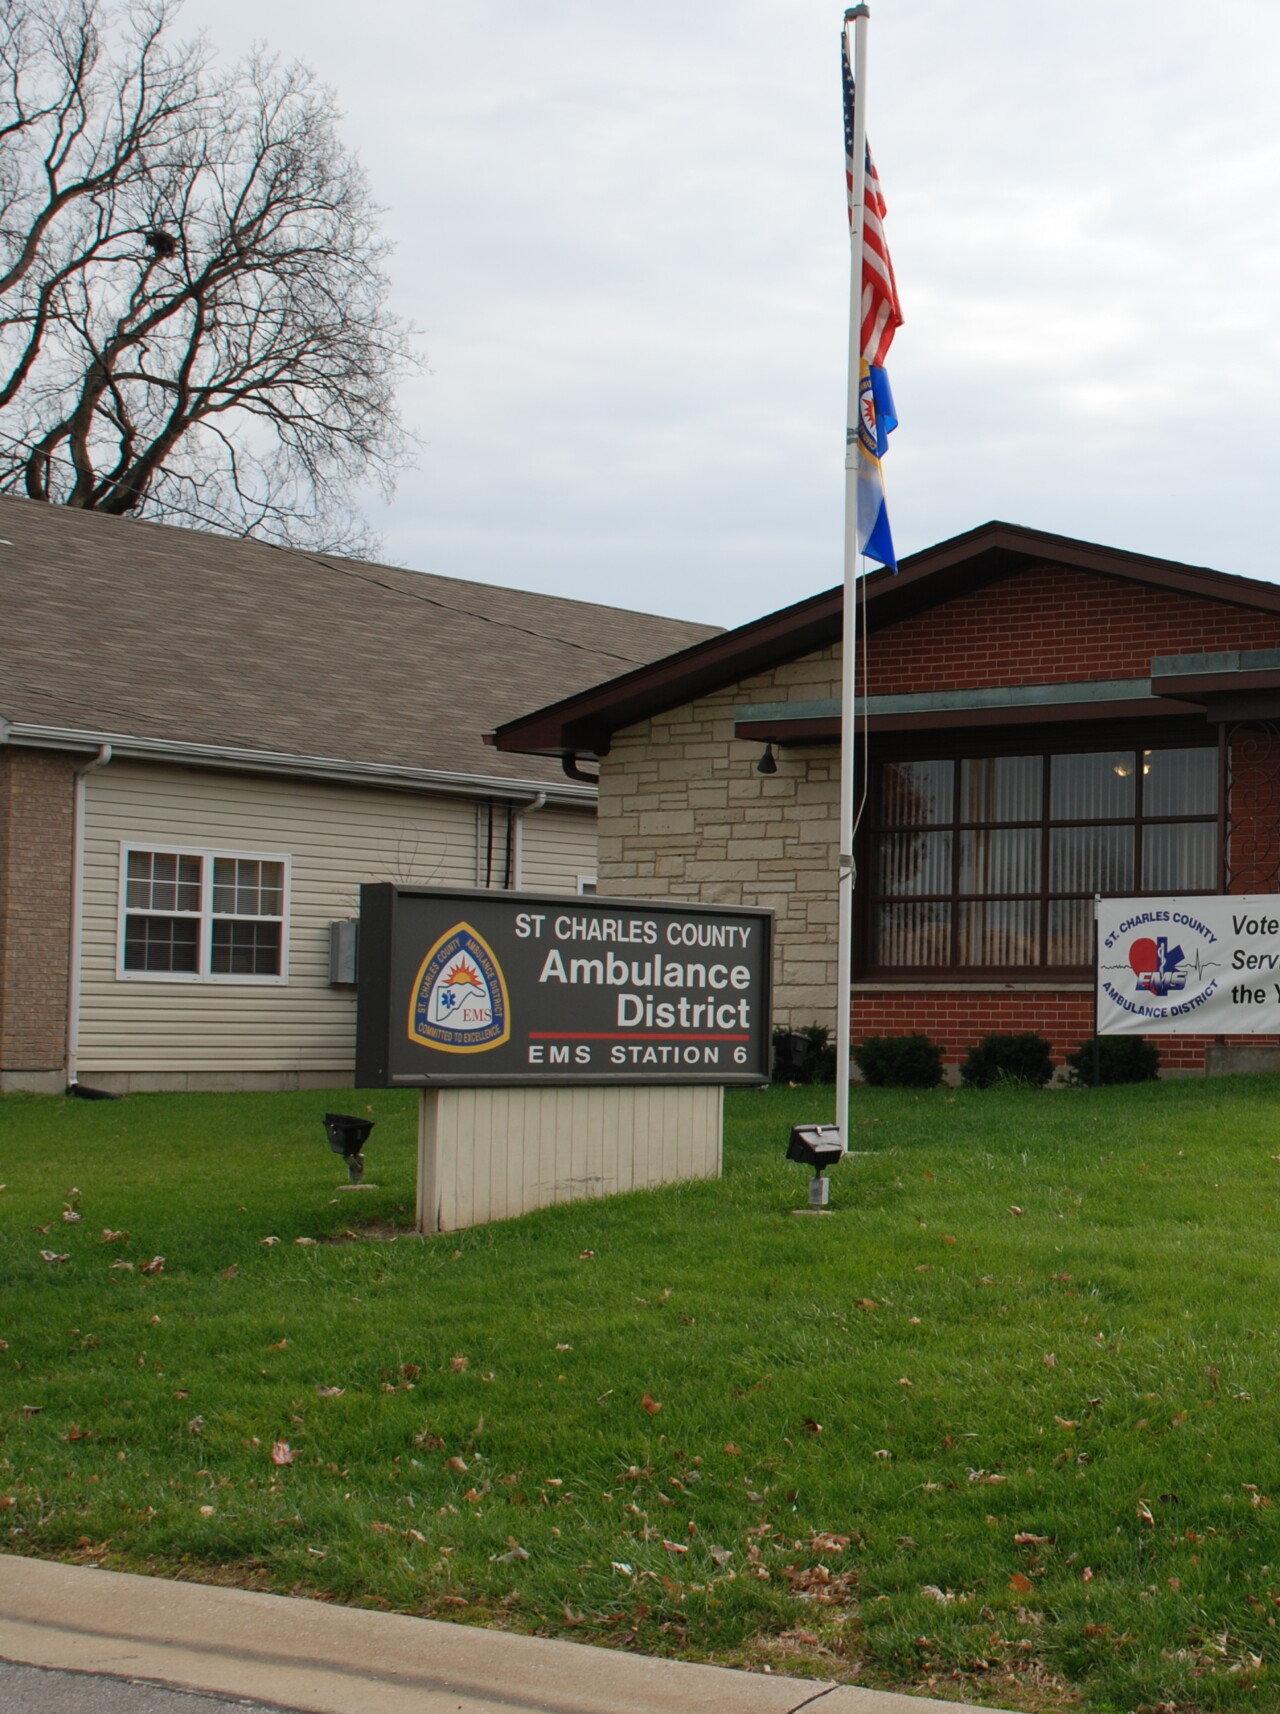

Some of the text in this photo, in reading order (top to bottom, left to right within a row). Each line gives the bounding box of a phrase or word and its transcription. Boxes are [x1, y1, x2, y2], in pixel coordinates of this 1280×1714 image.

[515, 913, 751, 948] ST CHARLES COUNTY
[1104, 911, 1218, 949] ST. CHARLES COUNTY
[420, 962, 440, 998] CHARLES
[437, 937, 460, 962] COUNTY
[465, 939, 503, 1017] AMBULANCE DISTRICT
[539, 949, 750, 989] Ambulance
[1135, 971, 1188, 991] EMS
[617, 993, 750, 1029] District
[1103, 979, 1218, 1018] AMBULANCE DISTRICT
[1232, 984, 1266, 1004] the
[418, 1022, 501, 1043] COMMITTED TO EXCELLENCE
[463, 1009, 492, 1022] EMS
[528, 1045, 748, 1064] EMS STATION 6
